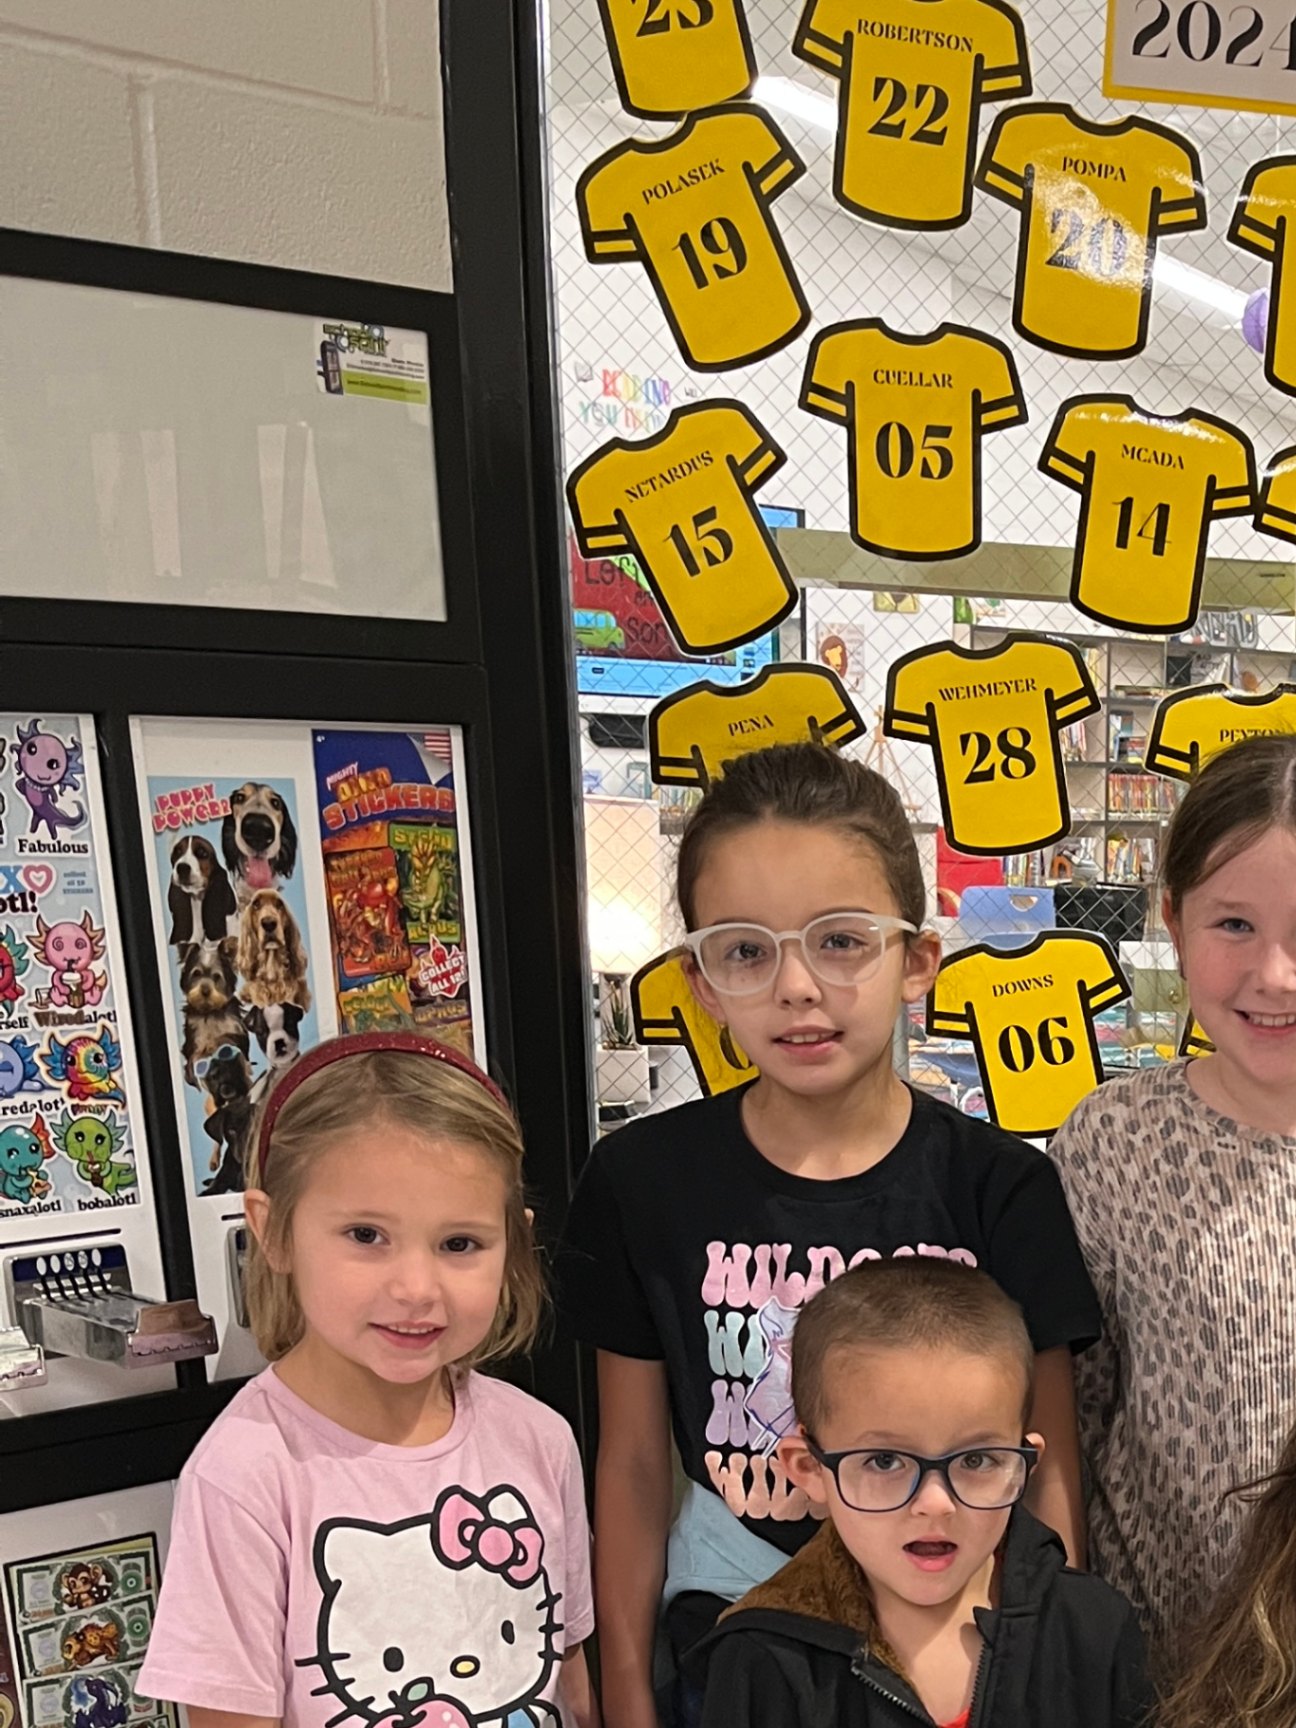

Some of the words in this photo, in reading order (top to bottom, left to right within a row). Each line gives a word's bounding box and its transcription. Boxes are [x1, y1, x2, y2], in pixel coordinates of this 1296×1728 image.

[857, 18, 973, 54] ROBERTSON
[868, 77, 948, 146] 22
[642, 162, 724, 204] POLASEK
[1063, 157, 1126, 181] POMPA
[674, 217, 747, 289] 19
[1045, 208, 1130, 277] 20
[874, 370, 952, 388] CUELLAR
[876, 422, 953, 479] 05
[1123, 445, 1183, 469] MCADA
[624, 450, 714, 504] NETARDUS
[667, 506, 733, 577] 15
[1111, 497, 1172, 556] 14
[939, 679, 1036, 701] WEHMEYER
[729, 715, 773, 736] PENA
[960, 727, 1036, 784] 28
[155, 783, 215, 812] PUPPY
[322, 783, 455, 830] STICKERS
[18, 838, 89, 855] Fabulous
[421, 955, 465, 981] COLLECT
[993, 975, 1053, 997] DOWNS
[999, 1017, 1074, 1072] 06
[78, 1193, 137, 1211] bobalotl
